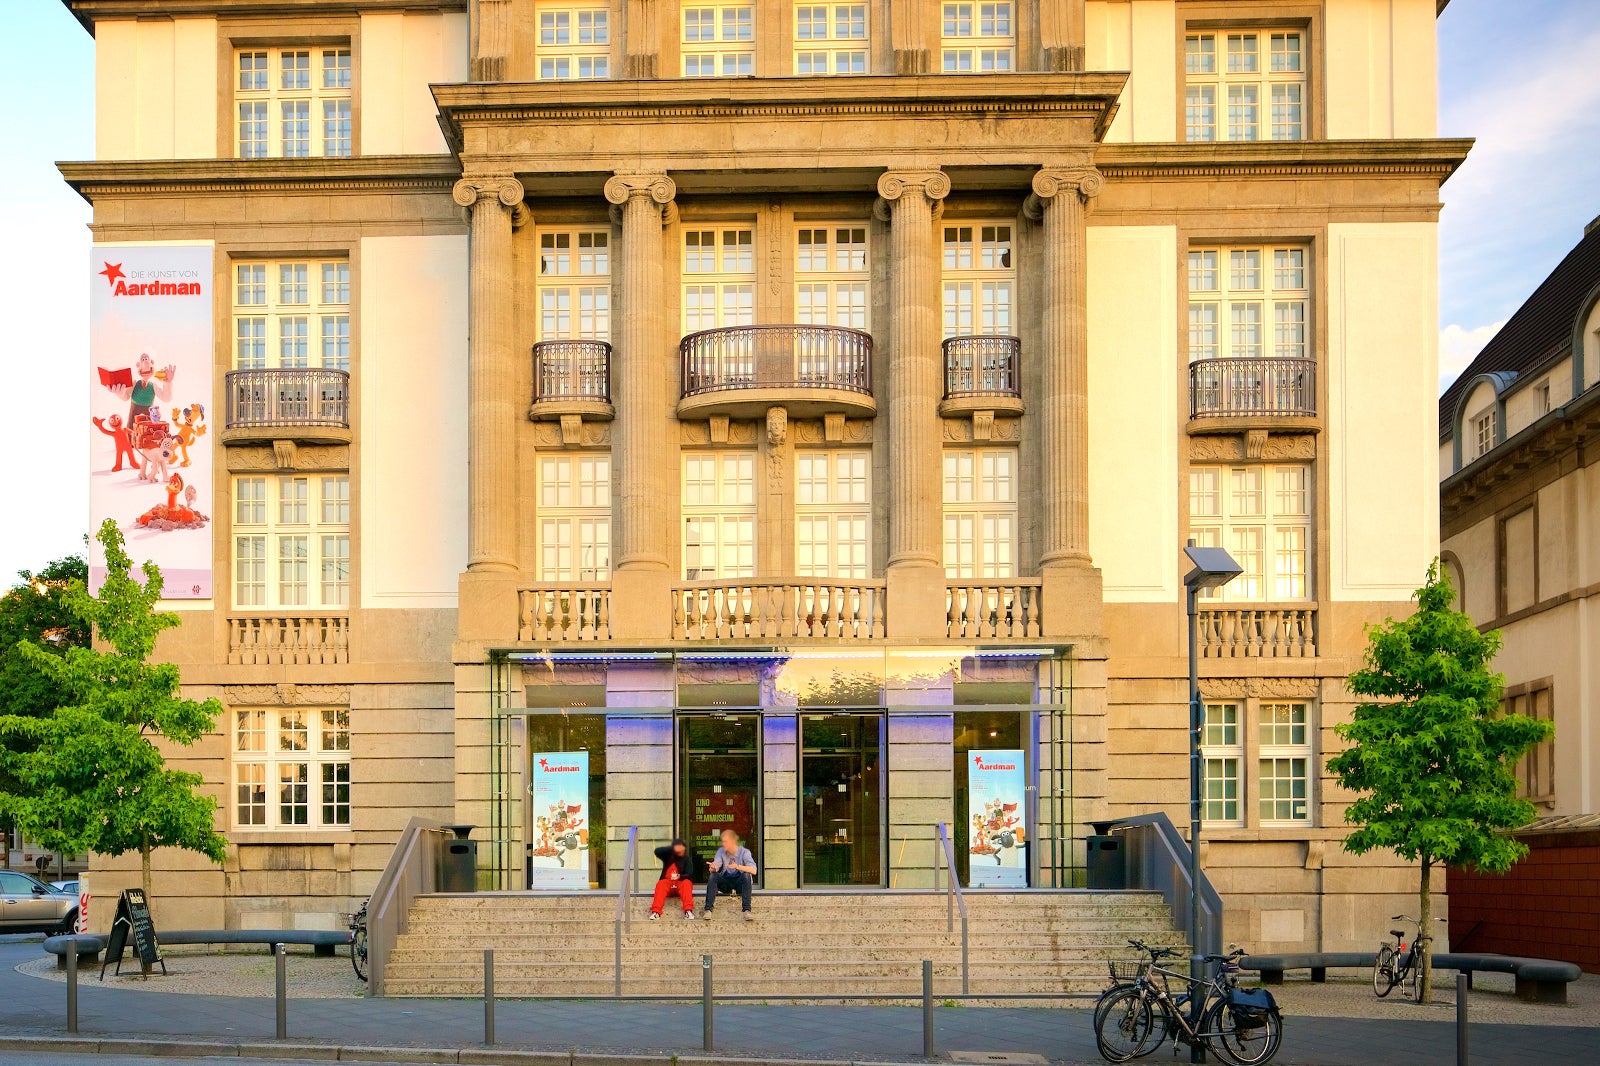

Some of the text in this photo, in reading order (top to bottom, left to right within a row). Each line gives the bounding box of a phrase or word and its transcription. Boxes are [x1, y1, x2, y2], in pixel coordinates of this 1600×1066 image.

[131, 270, 198, 279] DIE KUNST VON
[113, 280, 201, 296] Aardman
[543, 765, 580, 773] Aardman
[978, 763, 1016, 771] Aardman
[696, 799, 710, 807] KINO
[696, 814, 735, 822] FILMMUSEUM
